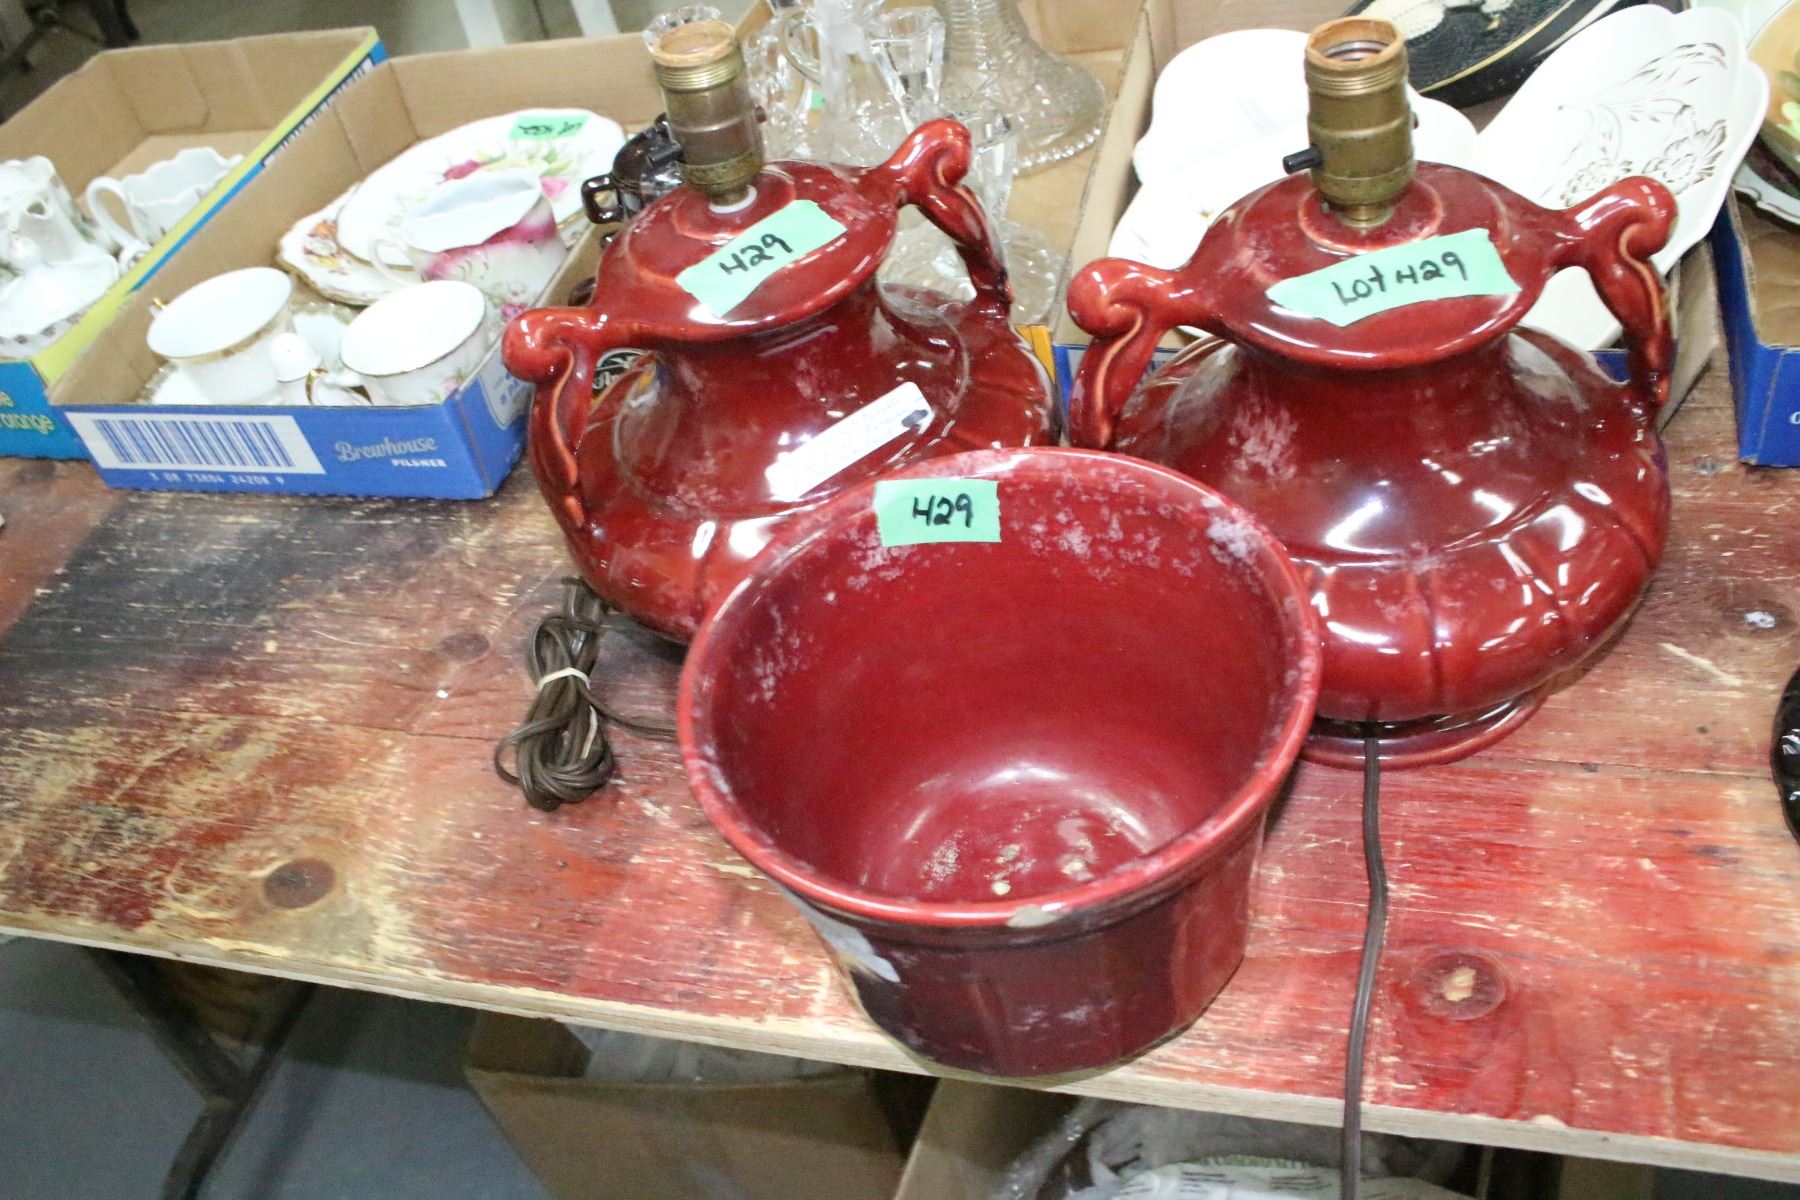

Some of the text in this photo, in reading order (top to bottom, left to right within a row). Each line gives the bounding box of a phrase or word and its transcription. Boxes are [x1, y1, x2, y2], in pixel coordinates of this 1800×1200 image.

[719, 233, 793, 275] 429
[1331, 251, 1468, 306] Lot 429
[335, 436, 438, 461] Brewhouse
[391, 458, 448, 468] PILSNER
[912, 492, 973, 529] 429
